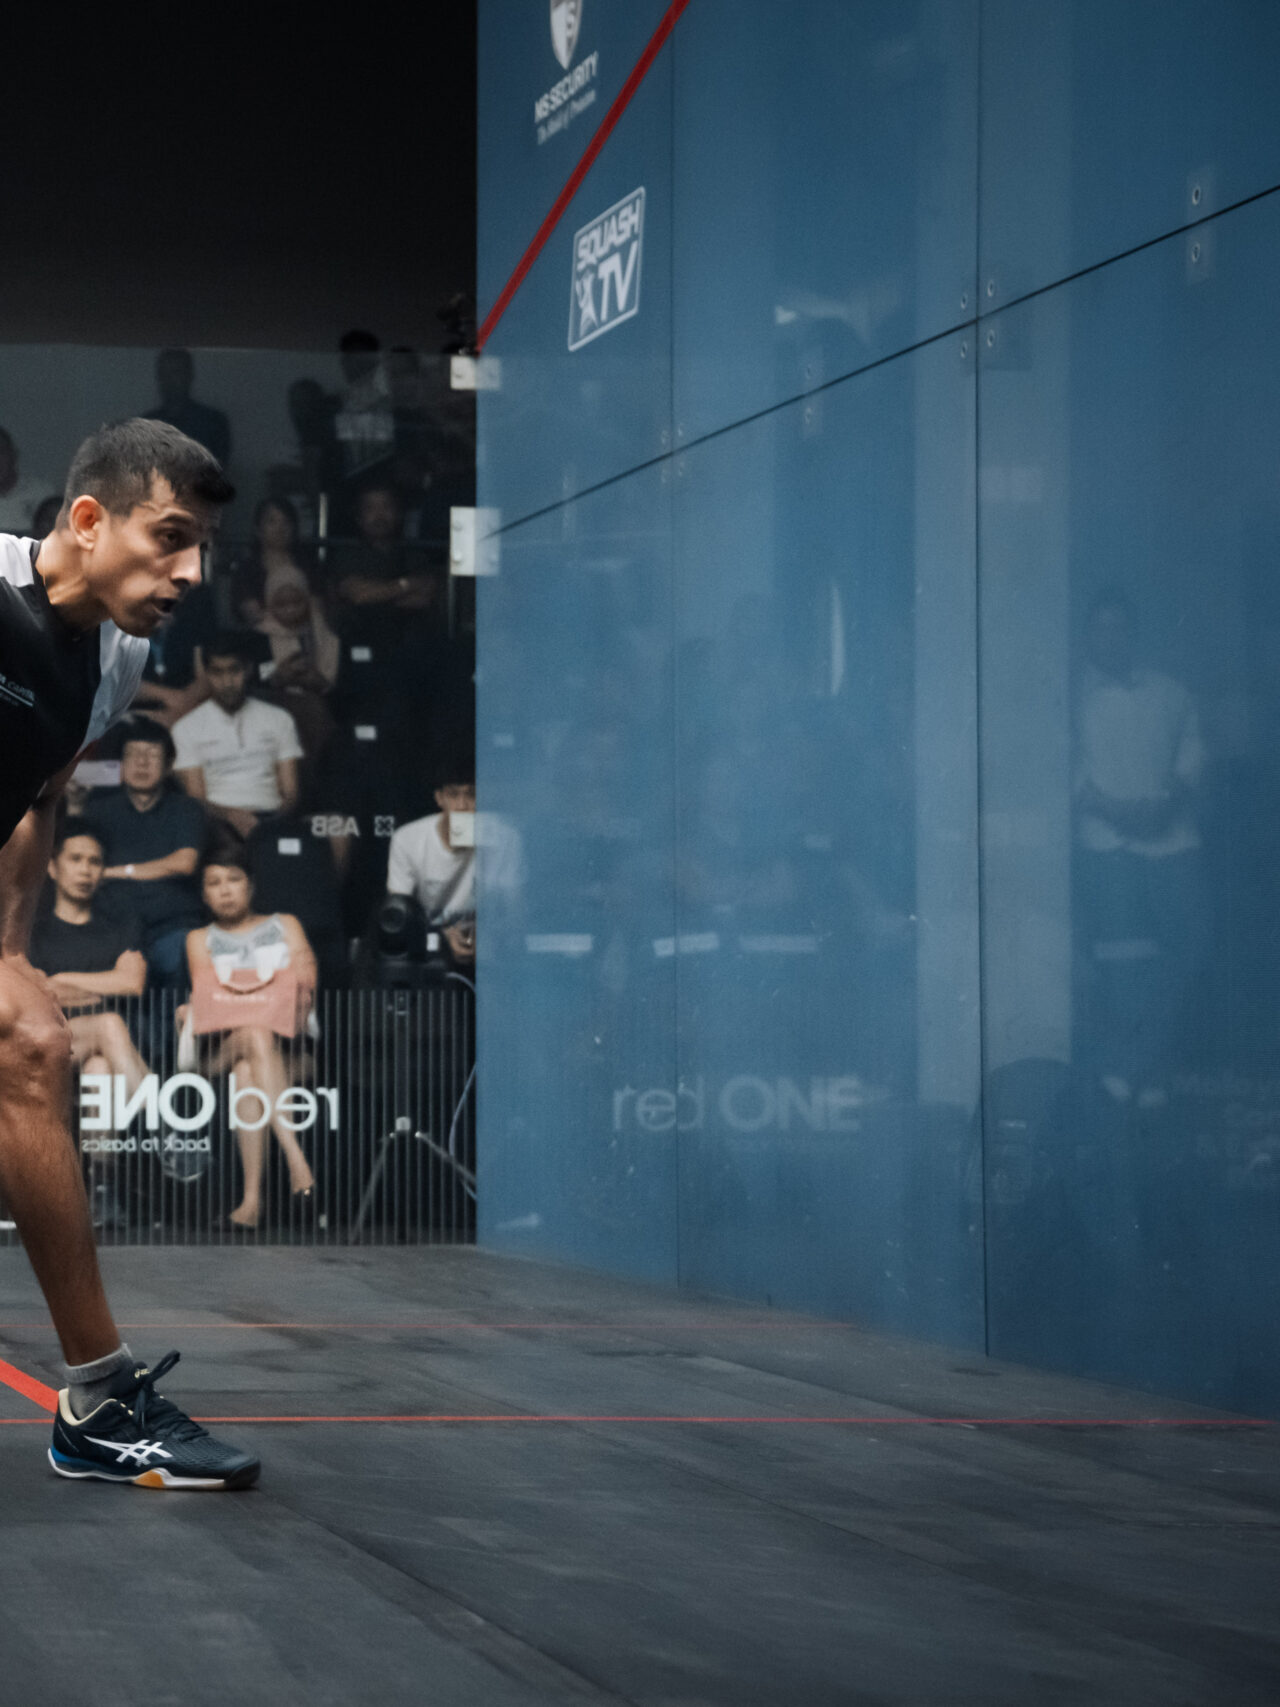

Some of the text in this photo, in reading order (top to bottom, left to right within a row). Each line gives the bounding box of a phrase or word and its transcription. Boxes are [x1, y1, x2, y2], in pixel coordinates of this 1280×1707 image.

[577, 198, 641, 272] SQUASH
[598, 240, 639, 322] TV
[719, 1074, 863, 1132] ONE
